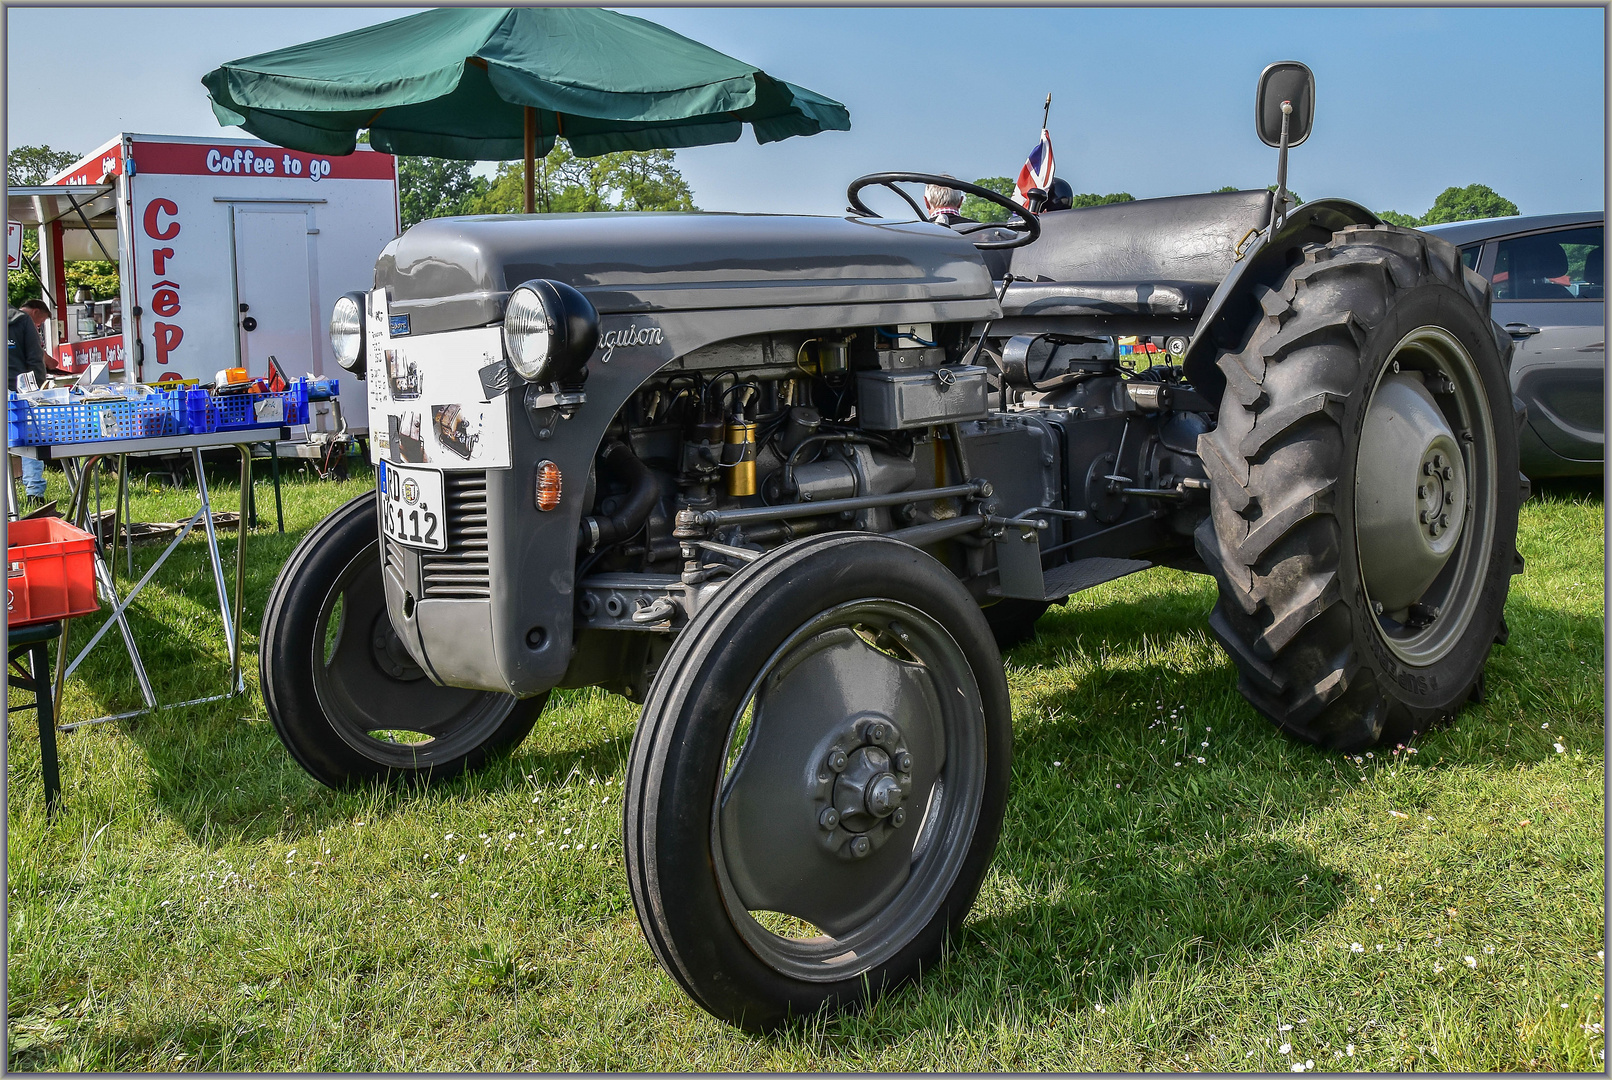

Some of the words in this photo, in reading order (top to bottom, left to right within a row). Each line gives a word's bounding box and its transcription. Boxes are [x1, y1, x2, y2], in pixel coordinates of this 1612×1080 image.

[206, 148, 275, 174] Coffee
[282, 154, 302, 175] to
[309, 159, 331, 182] go
[598, 324, 664, 363] rguson
[387, 467, 400, 502] RD
[397, 508, 439, 546] 112
